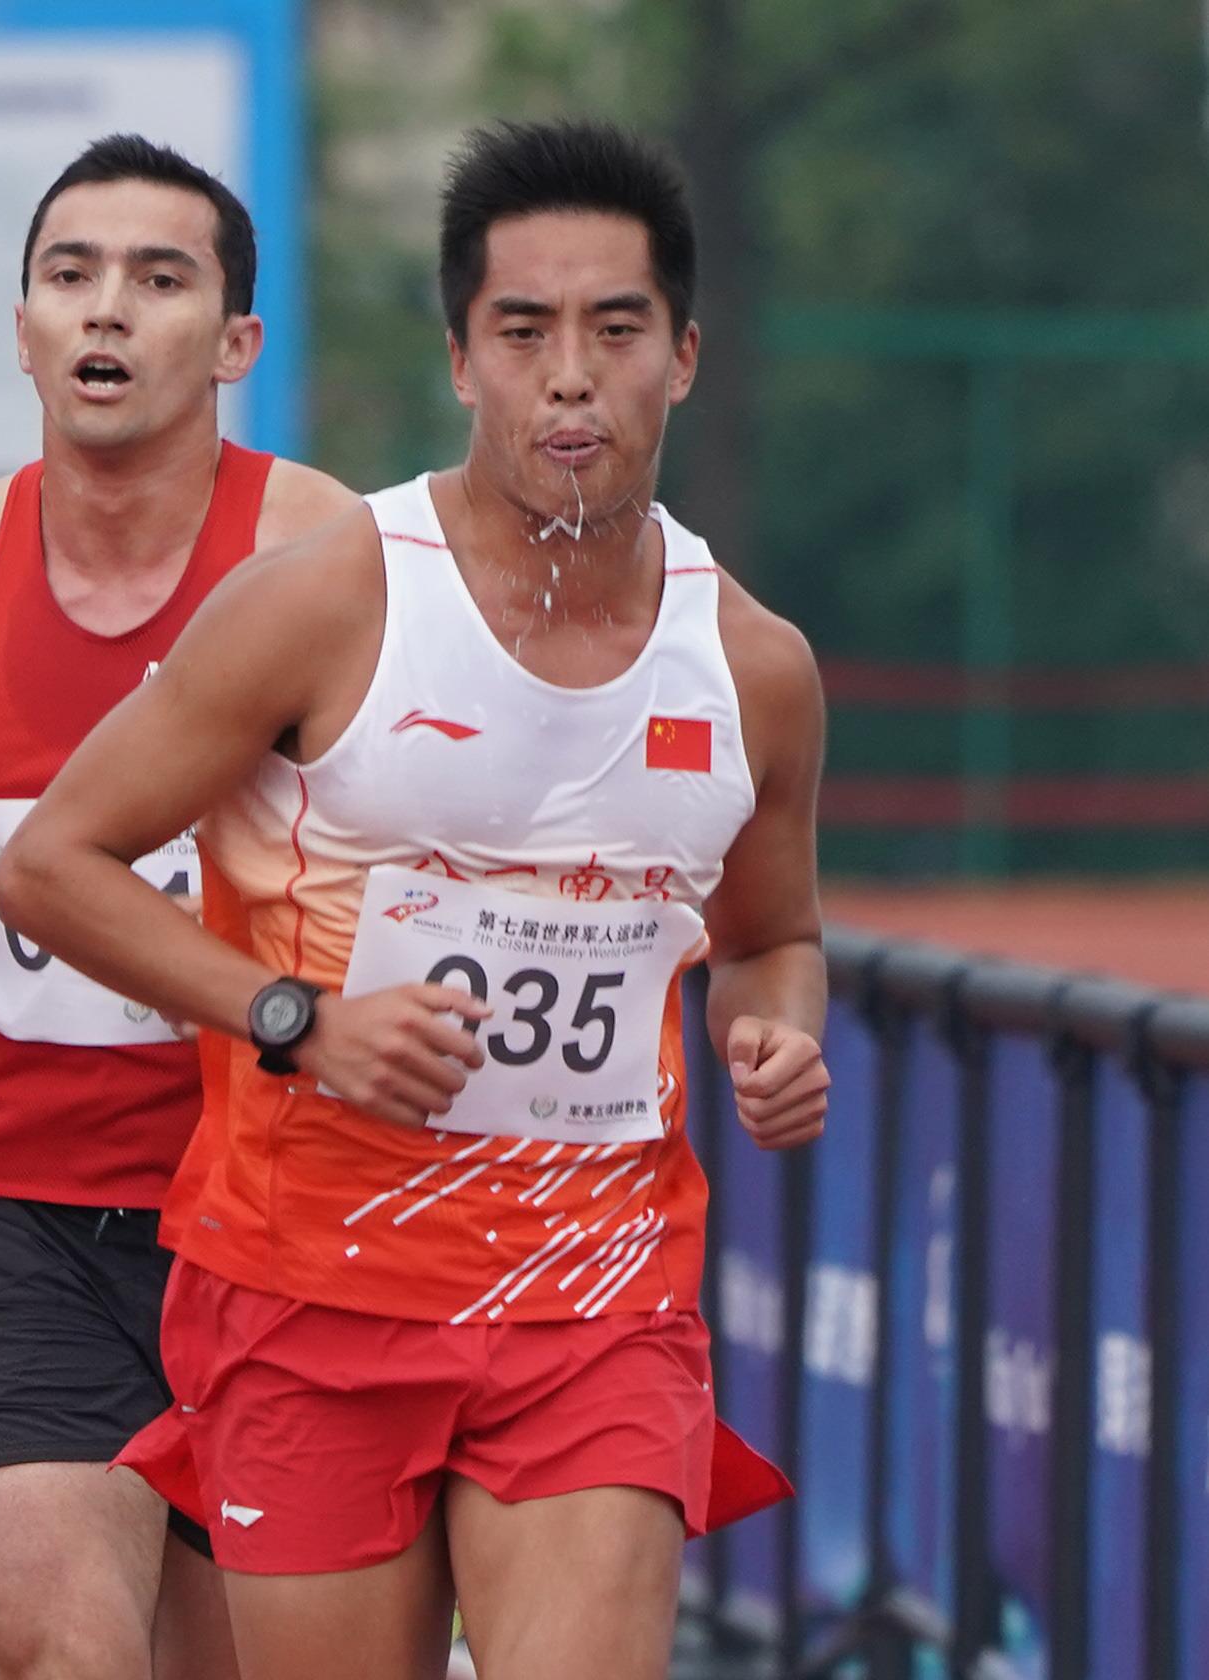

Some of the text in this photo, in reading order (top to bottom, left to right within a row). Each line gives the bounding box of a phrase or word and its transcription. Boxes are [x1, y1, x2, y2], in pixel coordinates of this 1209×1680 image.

[478, 908, 659, 944] 第七届世界军人运动会
[472, 929, 493, 947] 7th
[497, 937, 535, 955] CISM
[538, 943, 584, 961] Military
[589, 945, 621, 959] World
